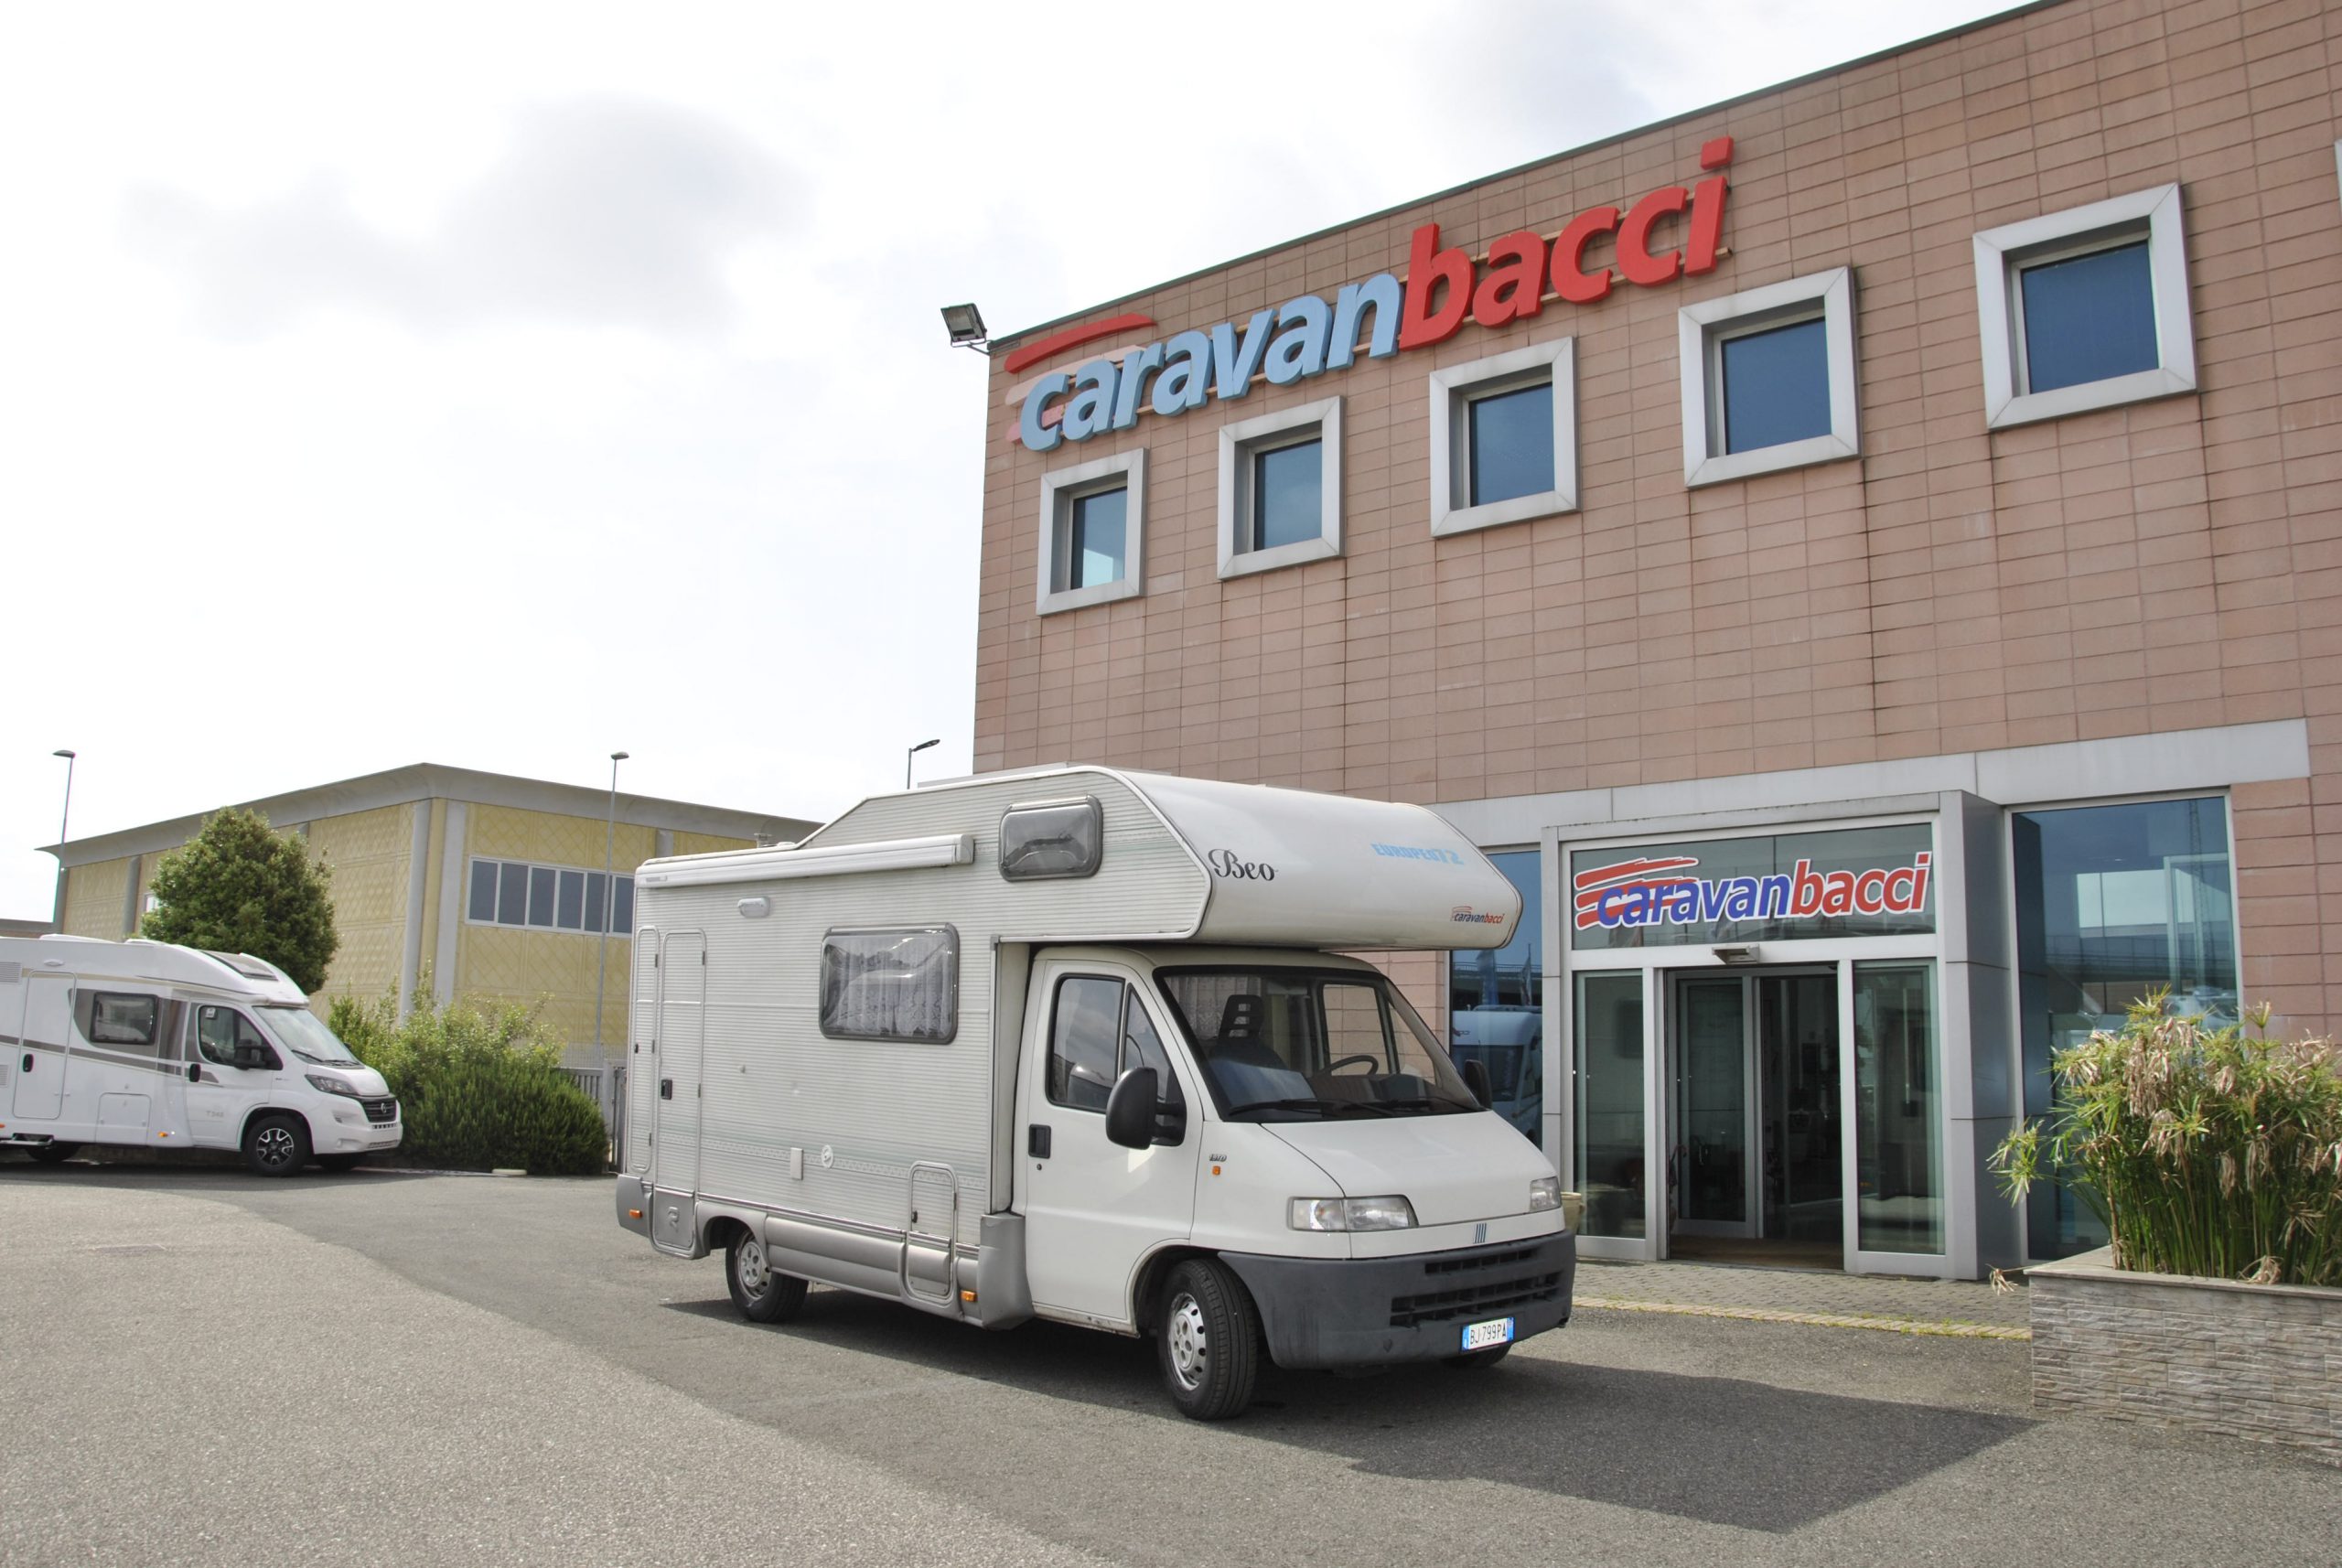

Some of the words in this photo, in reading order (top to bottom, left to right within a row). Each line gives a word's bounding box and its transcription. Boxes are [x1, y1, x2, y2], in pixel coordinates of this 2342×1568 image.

[1019, 135, 1734, 452] caravanbacci
[1208, 849, 1274, 881] Beo
[1597, 851, 1931, 928] caravanbacci
[1454, 912, 1505, 923] caravanbacci
